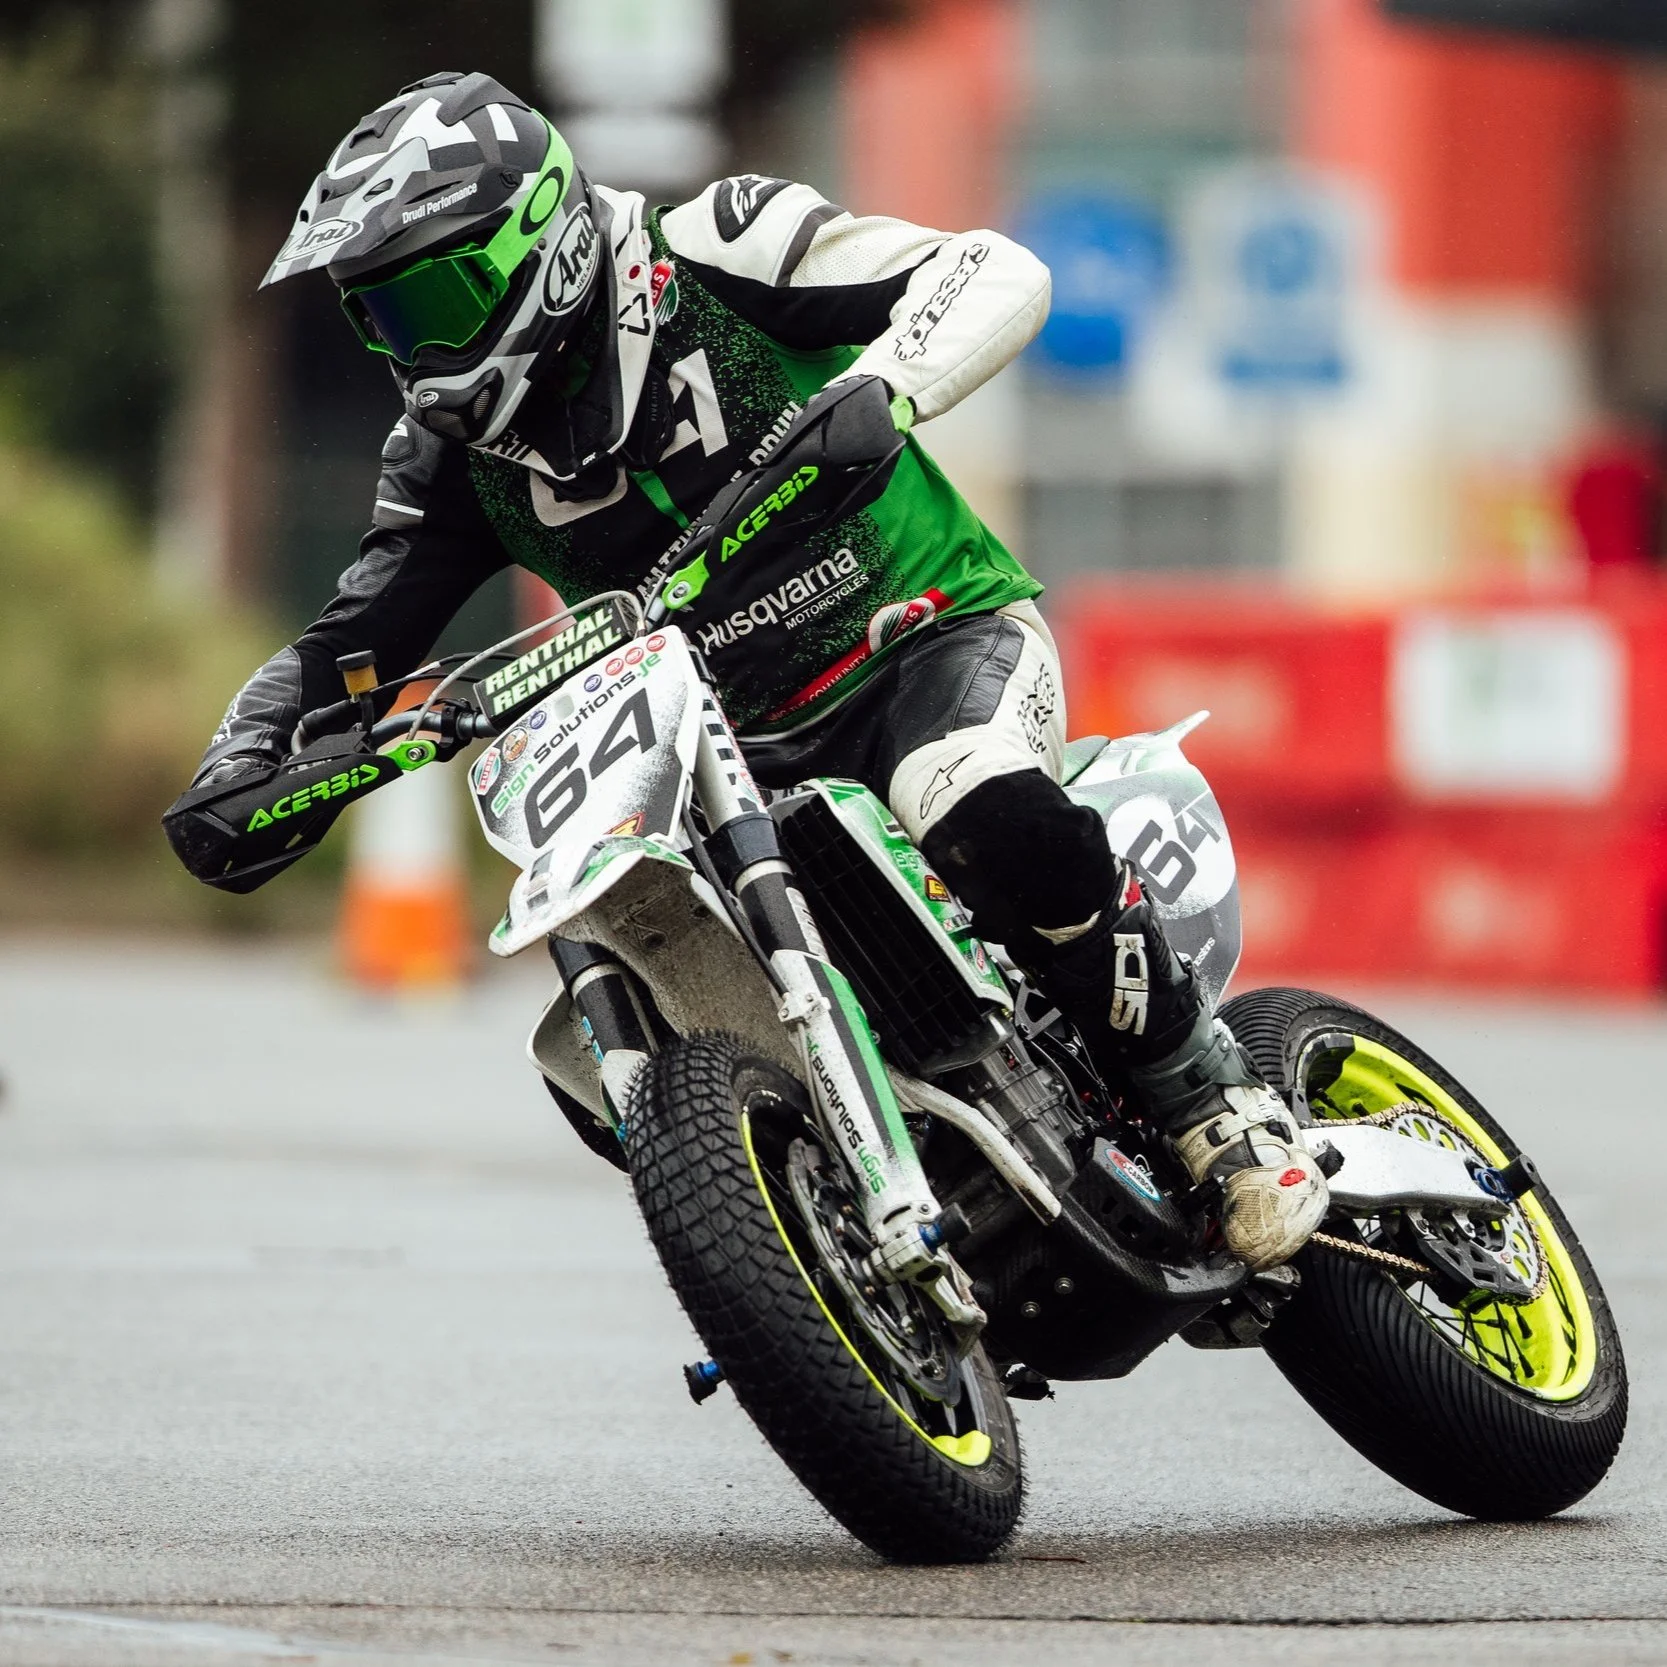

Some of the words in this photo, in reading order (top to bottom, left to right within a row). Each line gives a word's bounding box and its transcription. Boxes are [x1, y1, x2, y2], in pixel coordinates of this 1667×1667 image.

[426, 183, 478, 215] Performance
[556, 211, 595, 310] Arai
[721, 465, 819, 563] ACERBIS
[696, 547, 859, 656] Husqvarna
[785, 573, 870, 630] MOTORCYCLES
[484, 608, 614, 696] RENTHAL
[493, 624, 623, 716] RENTHAL
[246, 764, 380, 832] ACERBIS
[524, 687, 658, 849] 64
[1125, 803, 1221, 905] 64
[1109, 933, 1149, 1035] SIDI
